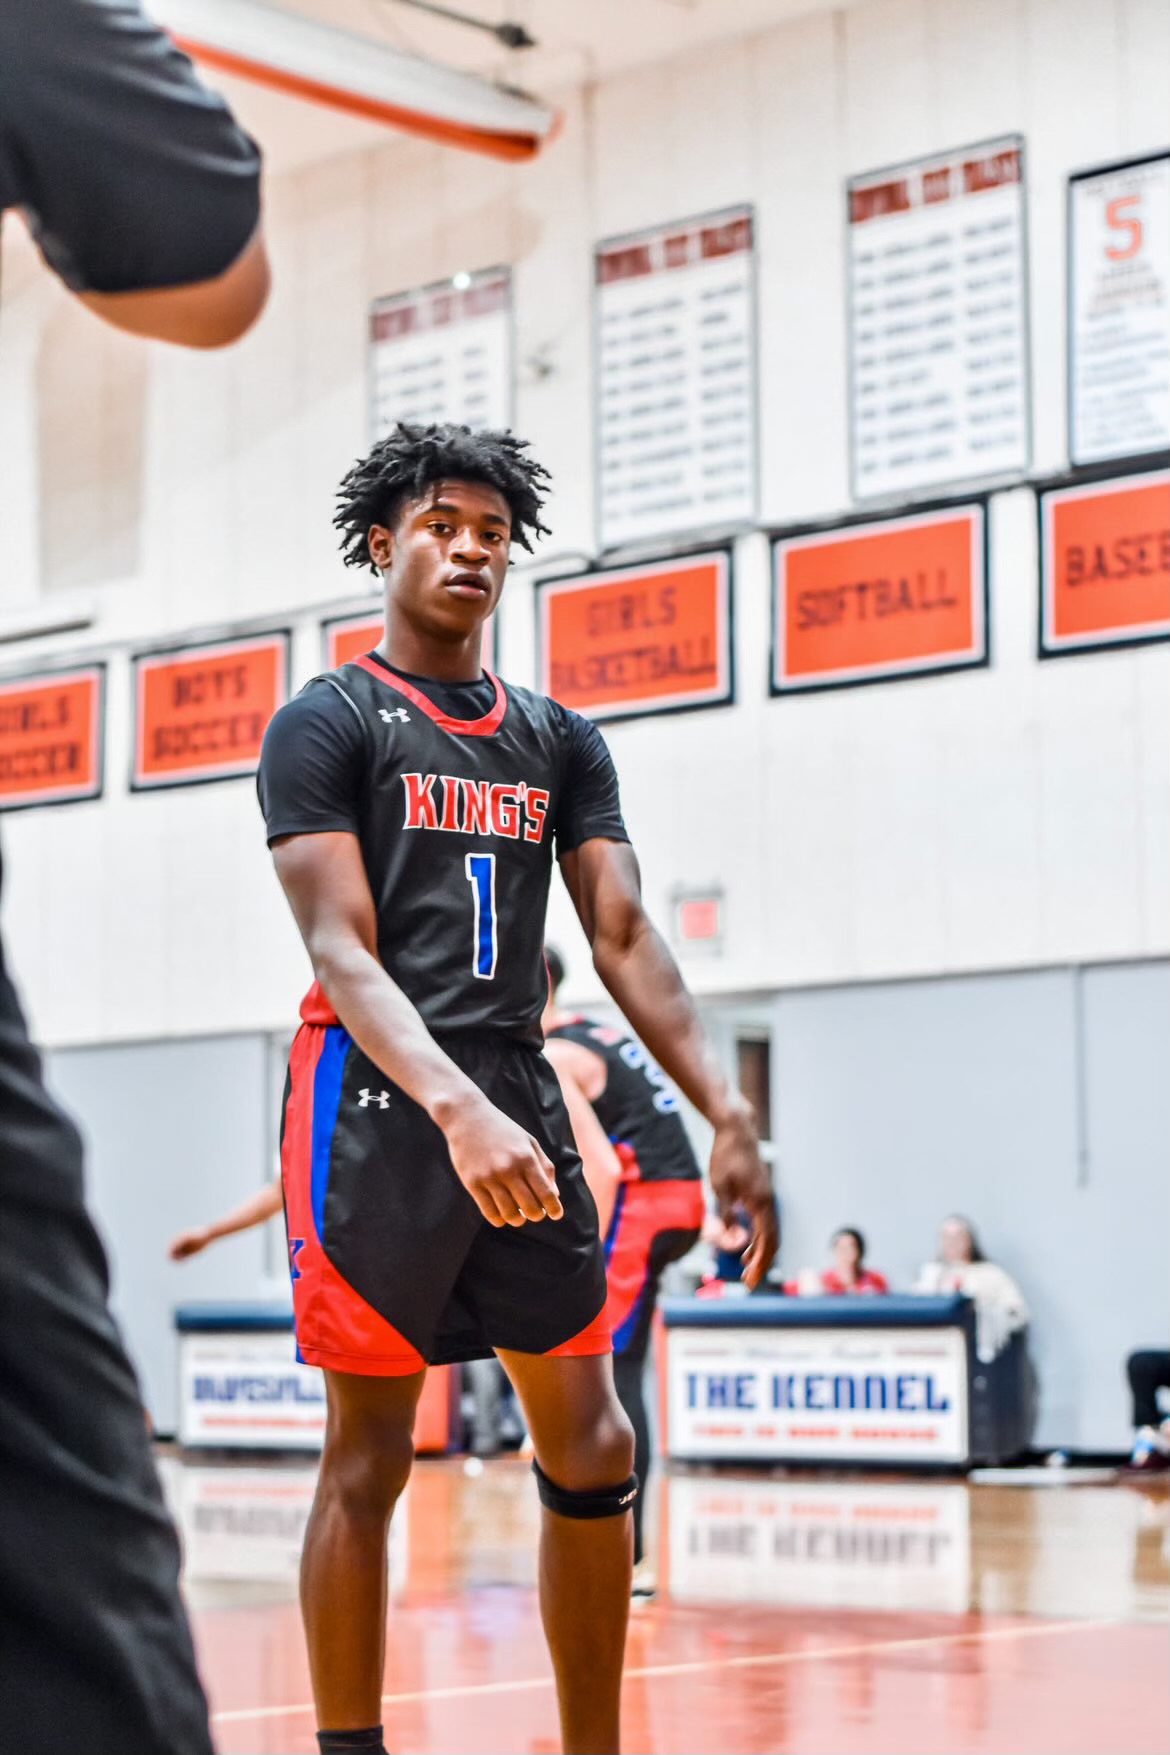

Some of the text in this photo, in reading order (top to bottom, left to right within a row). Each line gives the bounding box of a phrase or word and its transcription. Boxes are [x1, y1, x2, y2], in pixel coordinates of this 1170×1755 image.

[1105, 194, 1142, 261] 5
[797, 567, 957, 631] SOFTBALL
[400, 772, 550, 844] KING'S
[465, 852, 498, 980] 1
[686, 1372, 951, 1413] THE KENNEL
